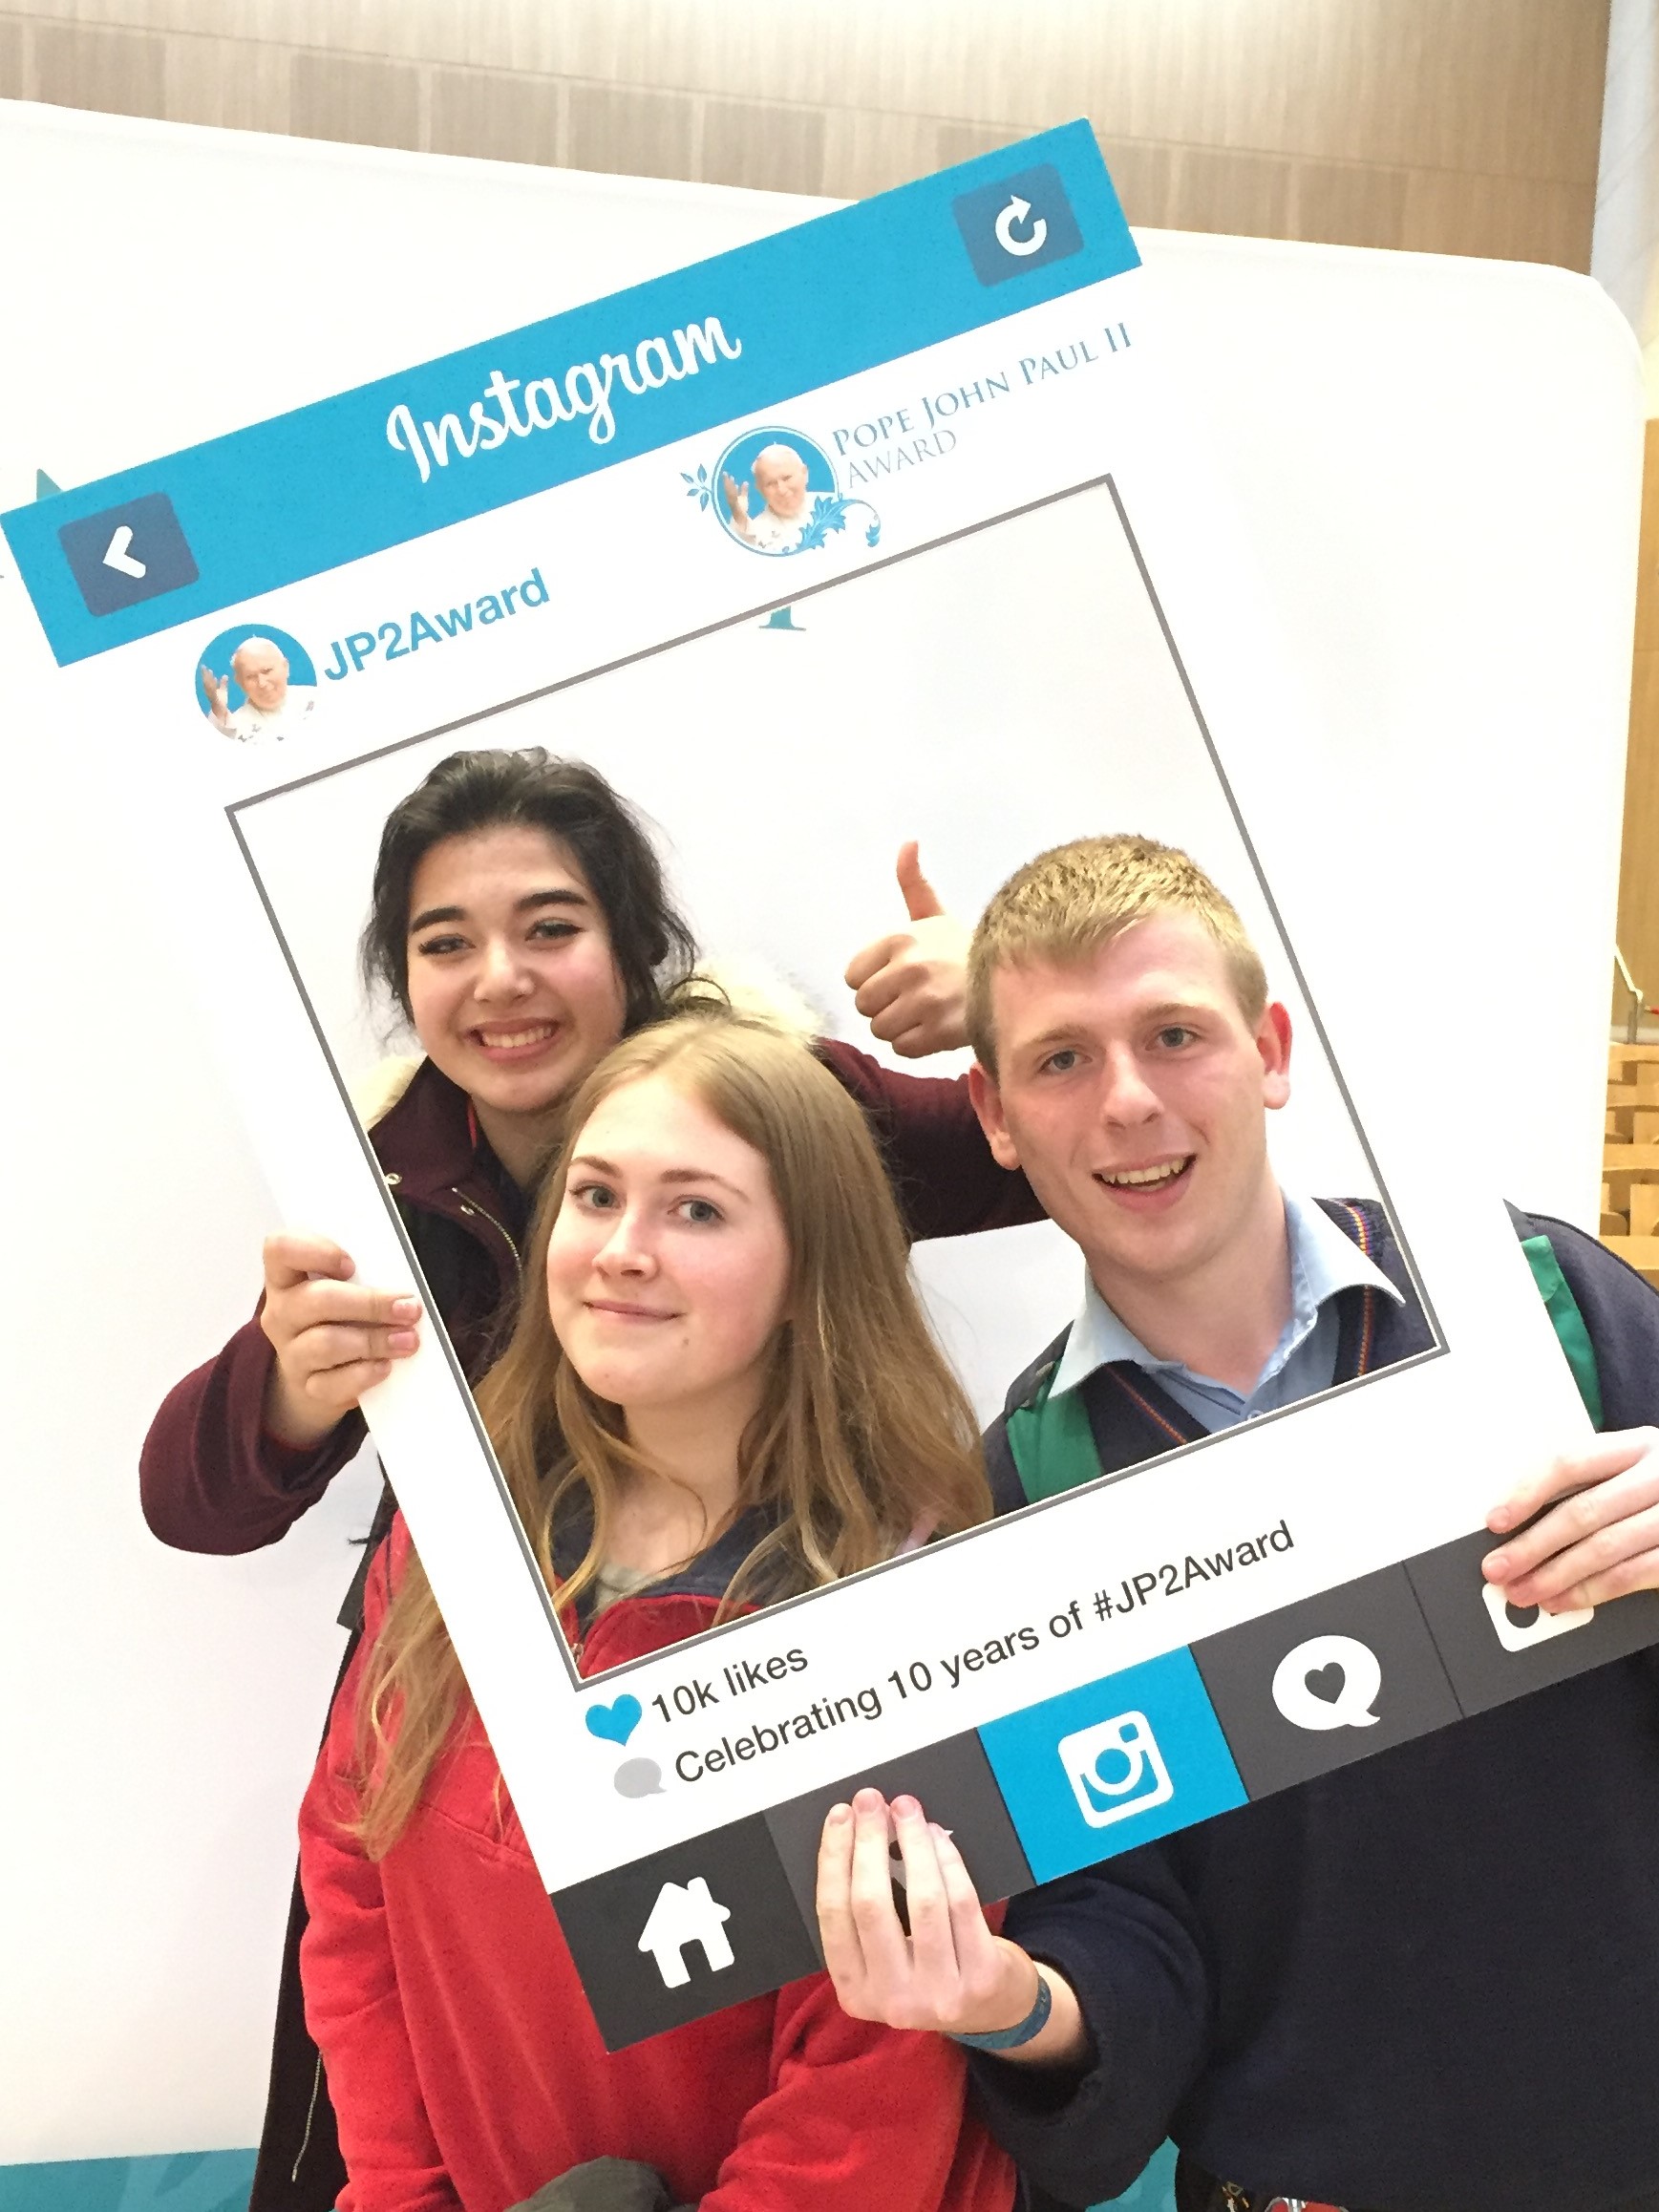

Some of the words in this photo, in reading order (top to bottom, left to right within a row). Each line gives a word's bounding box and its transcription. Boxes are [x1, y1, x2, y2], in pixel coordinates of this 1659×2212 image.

[386, 316, 742, 484] Instagram
[832, 408, 915, 457] POPE
[921, 372, 1010, 430] JOHN
[1018, 340, 1099, 386] PAUL
[1103, 322, 1132, 353] II
[848, 429, 957, 489] AWARD
[324, 566, 551, 681] JP2Award
[651, 1679, 720, 1723] 10k
[722, 1648, 809, 1697] likes
[674, 1686, 883, 1783] Celebrating
[887, 1660, 932, 1700] 10
[940, 1626, 1040, 1689] years
[1049, 1600, 1084, 1639] of
[1093, 1519, 1295, 1622] #JP2Award
